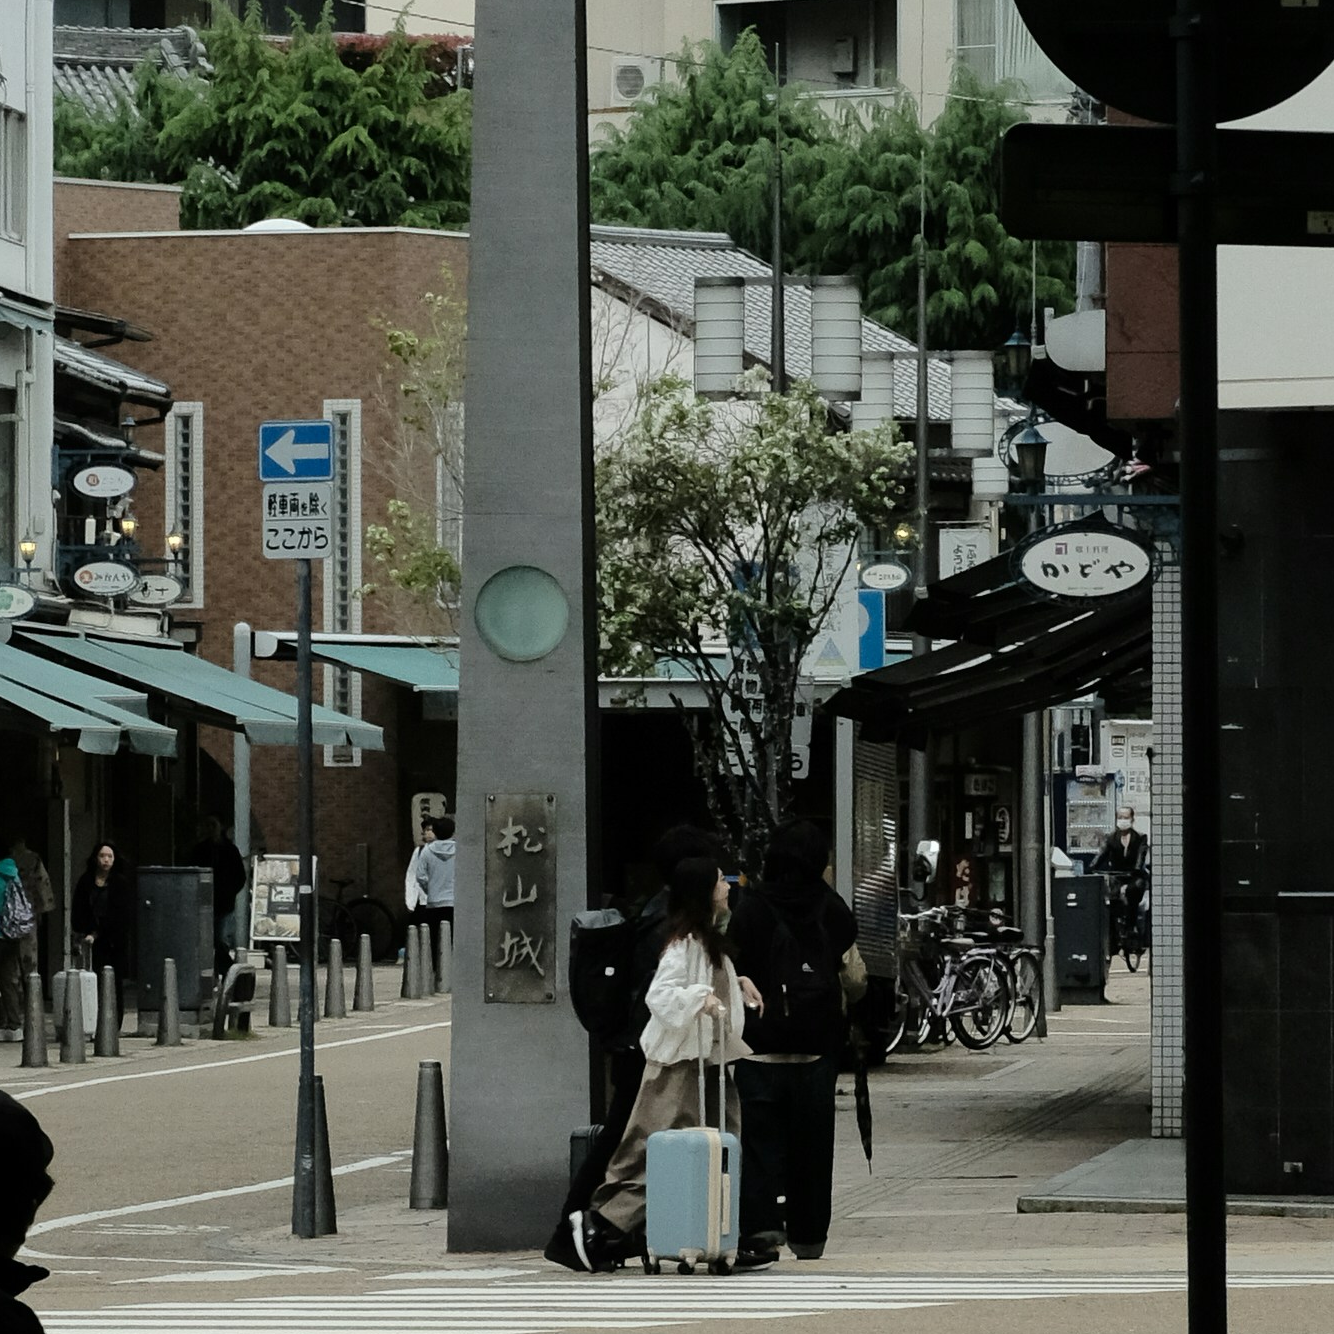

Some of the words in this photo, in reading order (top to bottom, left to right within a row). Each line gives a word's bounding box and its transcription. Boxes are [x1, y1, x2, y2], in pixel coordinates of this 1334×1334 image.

[268, 492, 327, 517] 軽車両を除く
[266, 527, 328, 550] ここから
[1041, 558, 1136, 579] かどや
[494, 817, 546, 977] 松山城
